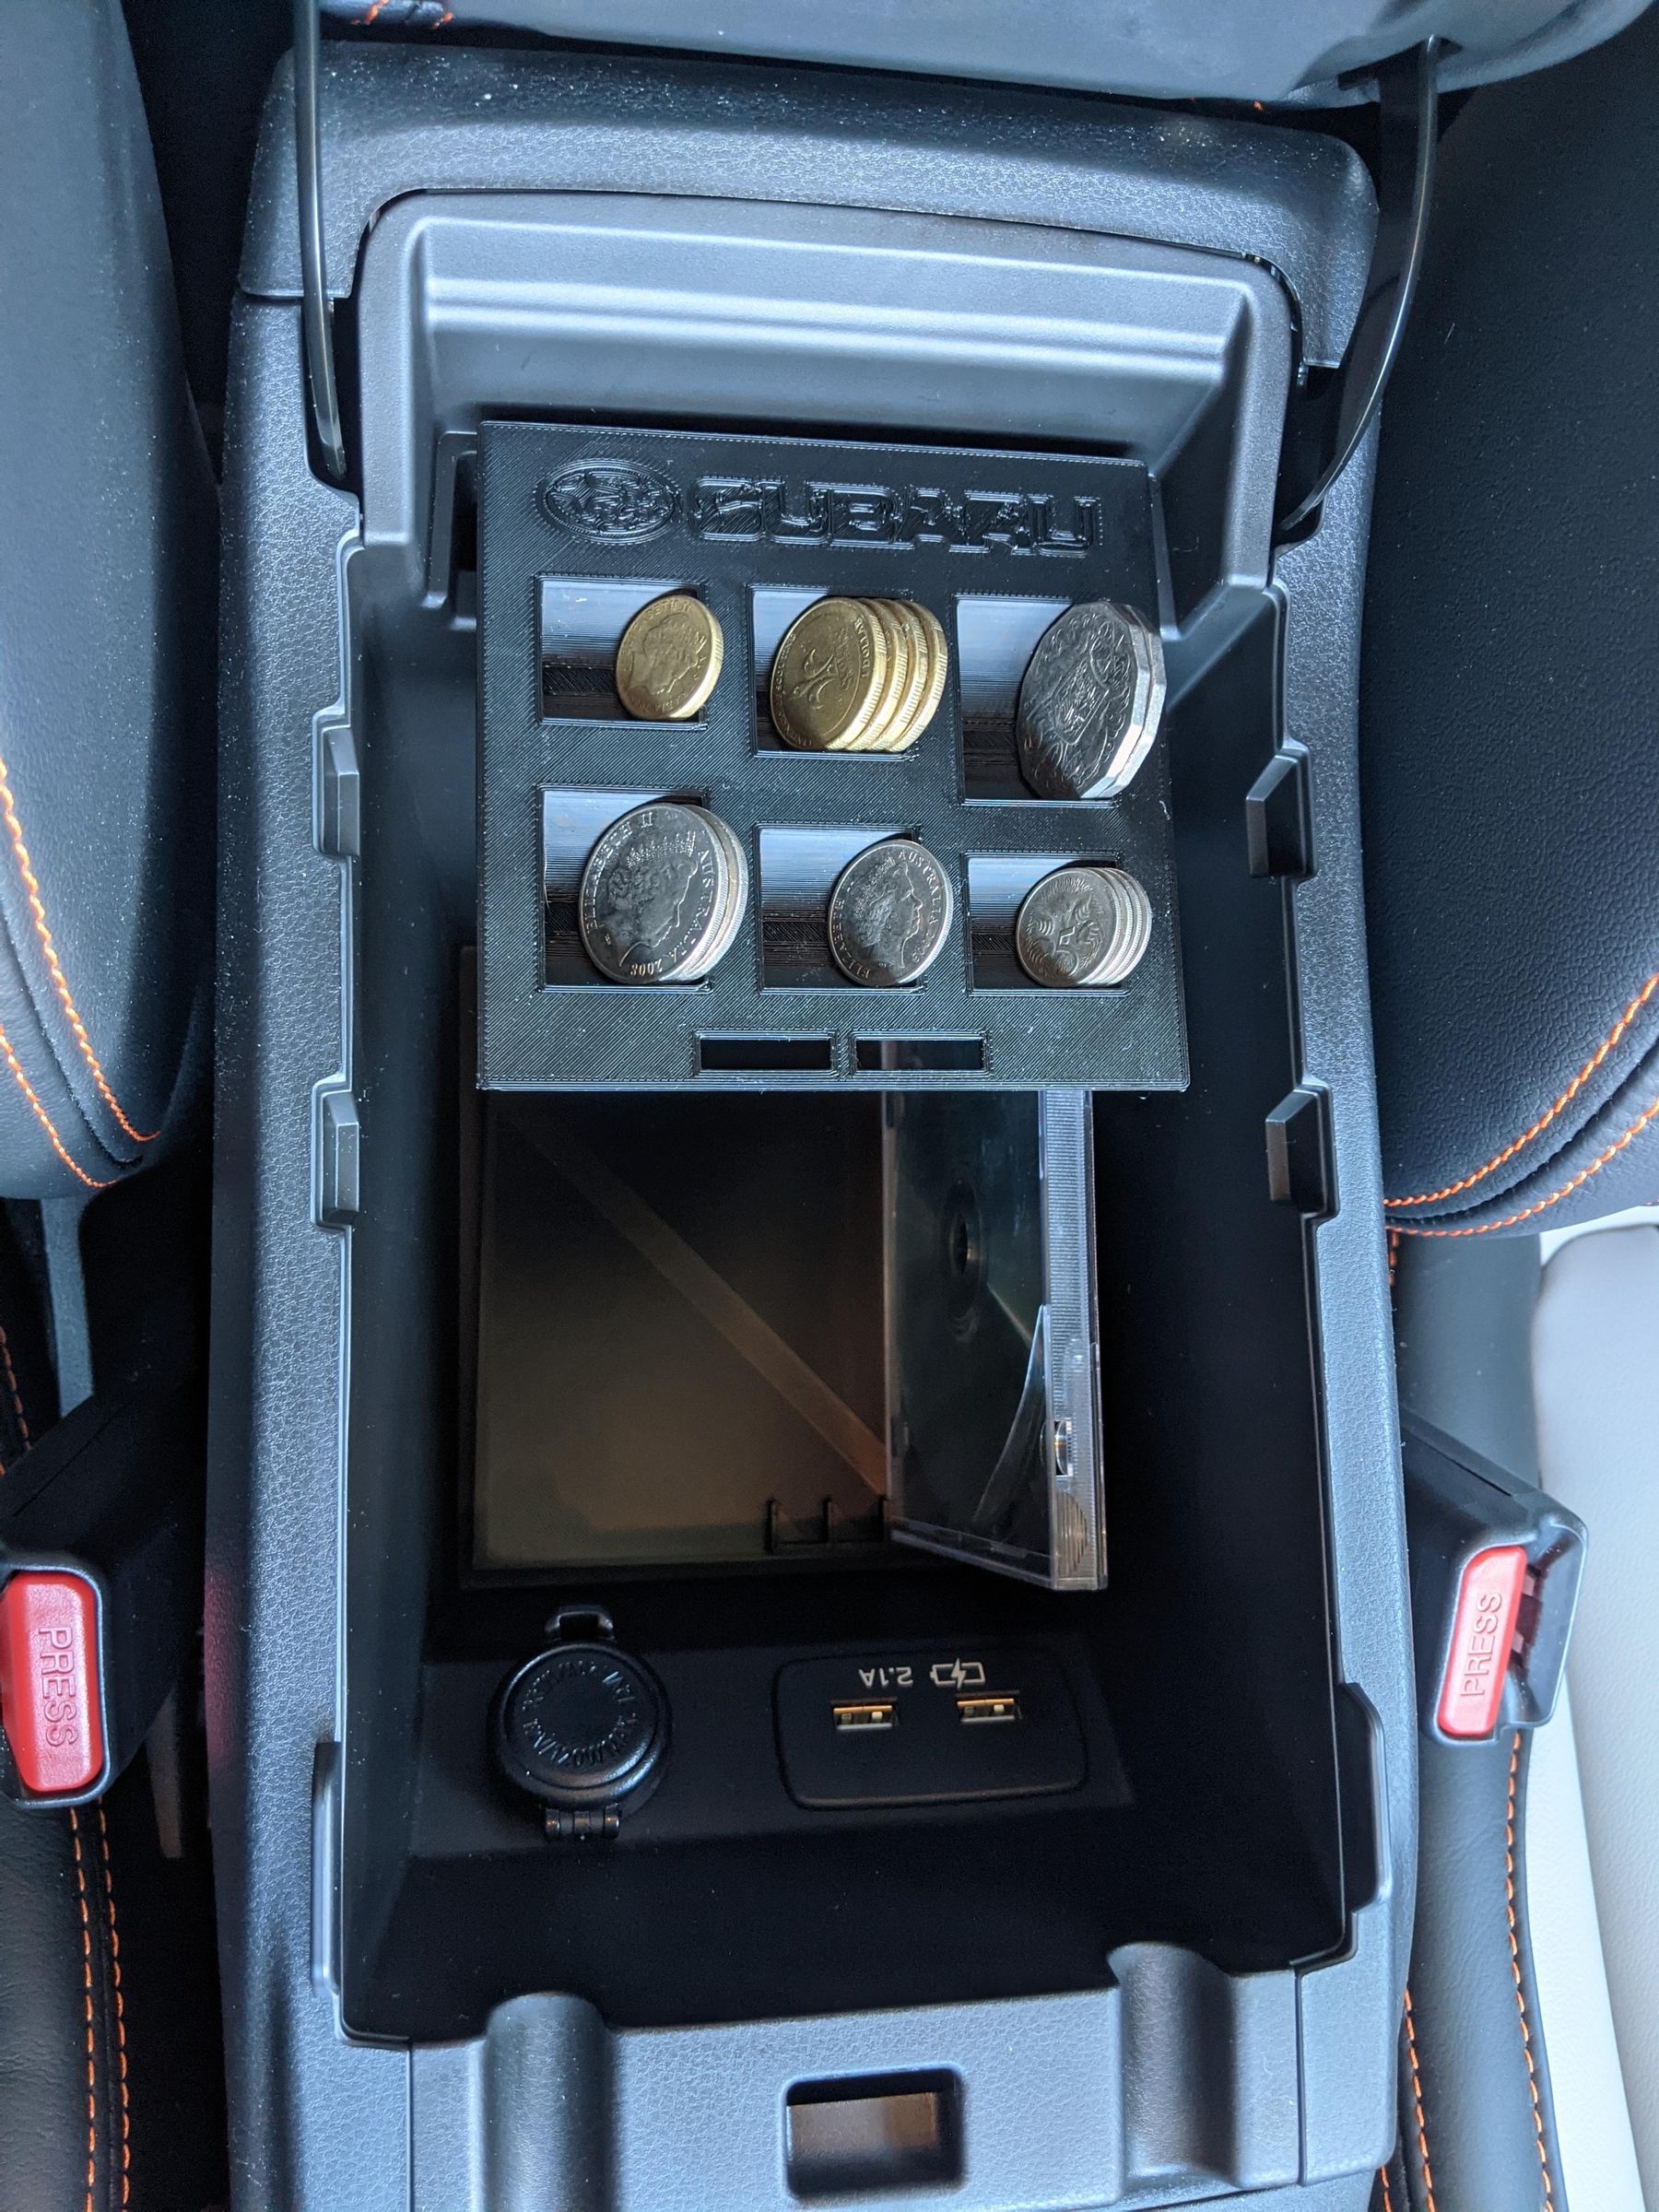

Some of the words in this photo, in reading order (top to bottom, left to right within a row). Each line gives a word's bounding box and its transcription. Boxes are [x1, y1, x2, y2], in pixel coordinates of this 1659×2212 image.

[688, 476, 1102, 557] SUBARU
[898, 849, 942, 925] AUSTRALIA
[858, 1666, 914, 1688] 2.1A
[1459, 1591, 1503, 1698] PRESS
[38, 1626, 79, 1747] PRESS
